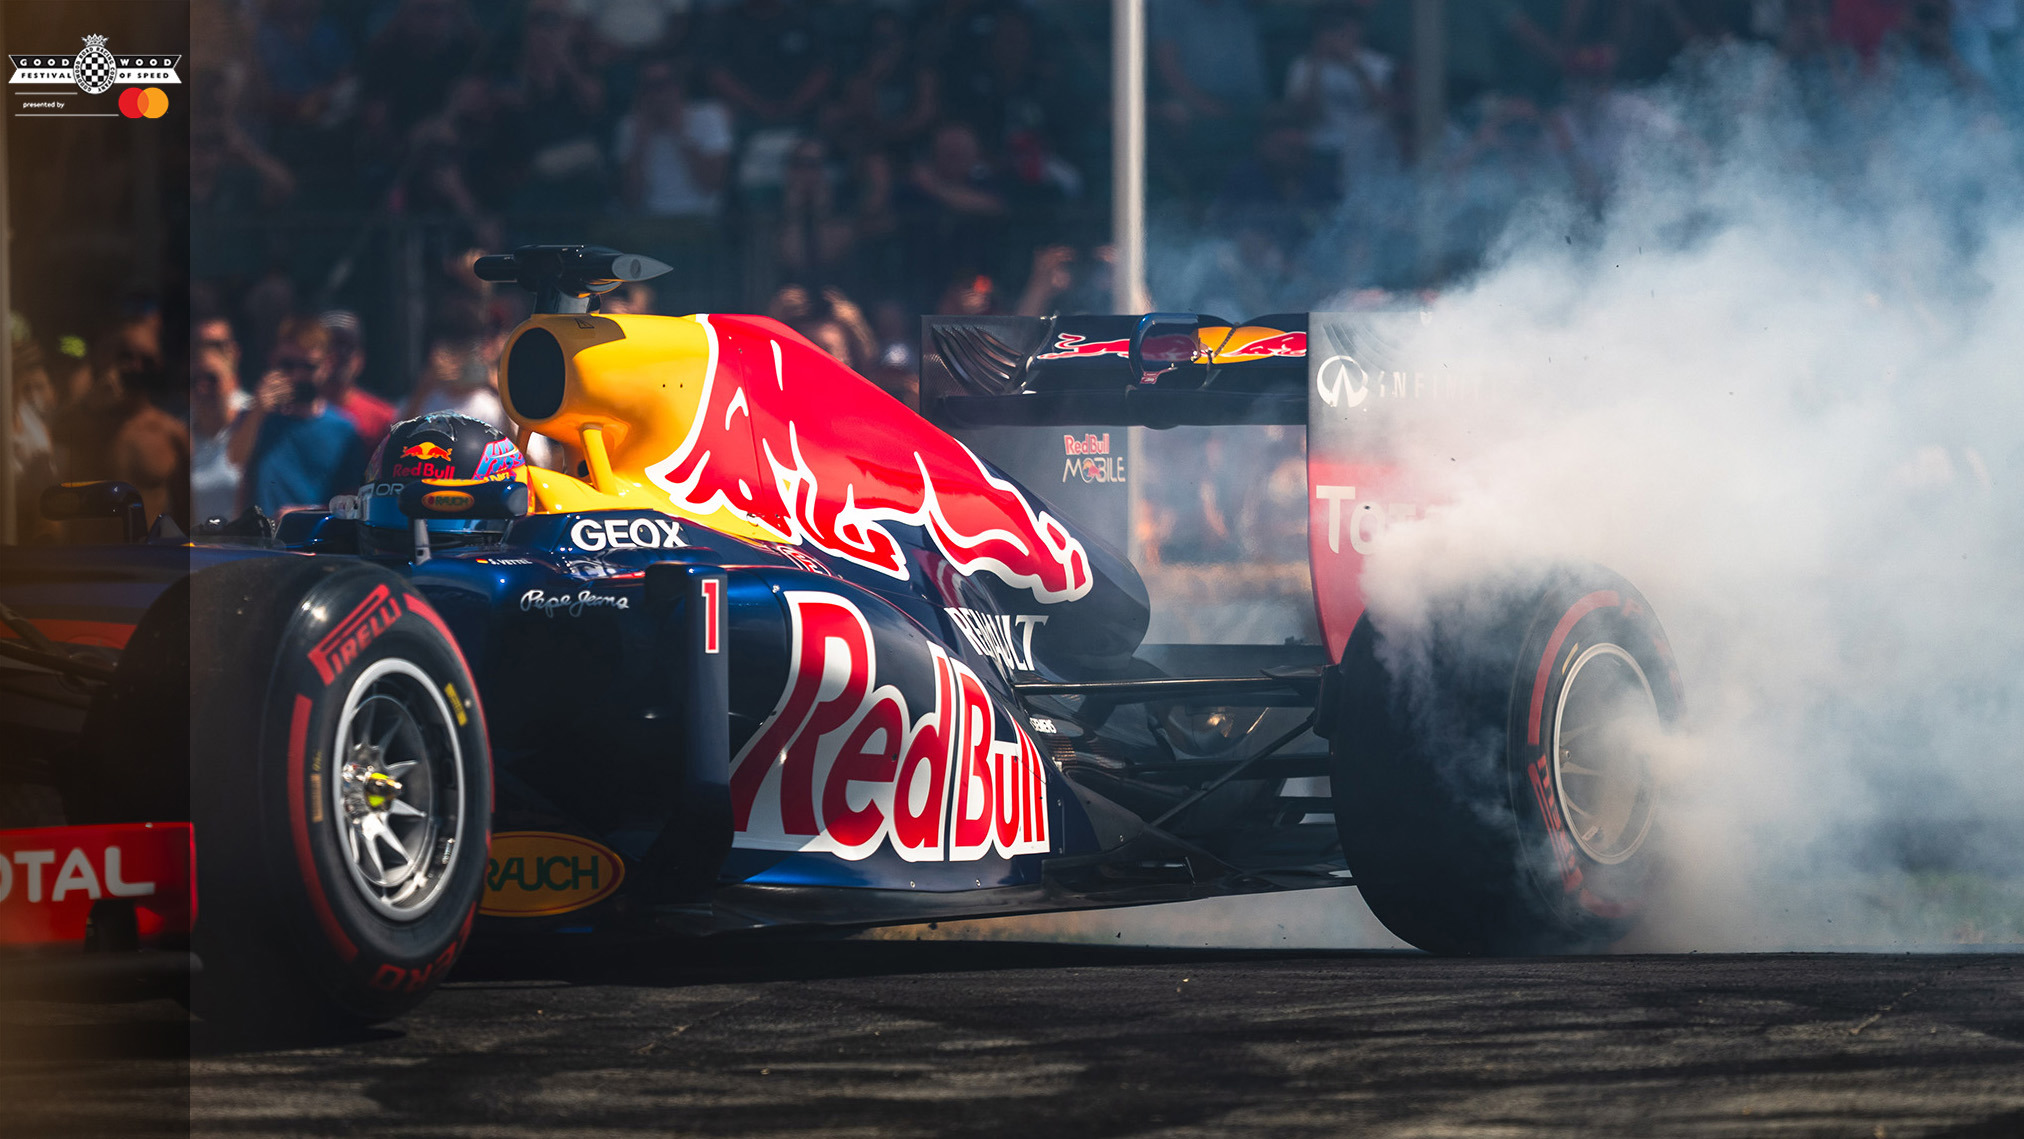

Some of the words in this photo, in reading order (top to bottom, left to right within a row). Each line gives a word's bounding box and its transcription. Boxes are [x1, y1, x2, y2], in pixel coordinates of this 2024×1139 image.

[1064, 433, 1089, 455] Red
[1089, 433, 1110, 454] Bull
[393, 462, 422, 478] Red
[422, 463, 456, 480] Bull
[1063, 457, 1126, 483] MOBILE
[570, 519, 691, 551] GEOX
[520, 590, 571, 618] Pepe
[569, 590, 629, 618] Jeans
[702, 579, 719, 654] 1
[307, 584, 402, 686] PIRELLI
[729, 590, 957, 862] Red
[949, 657, 1050, 862] Bull
[486, 855, 600, 892] RAUCH
